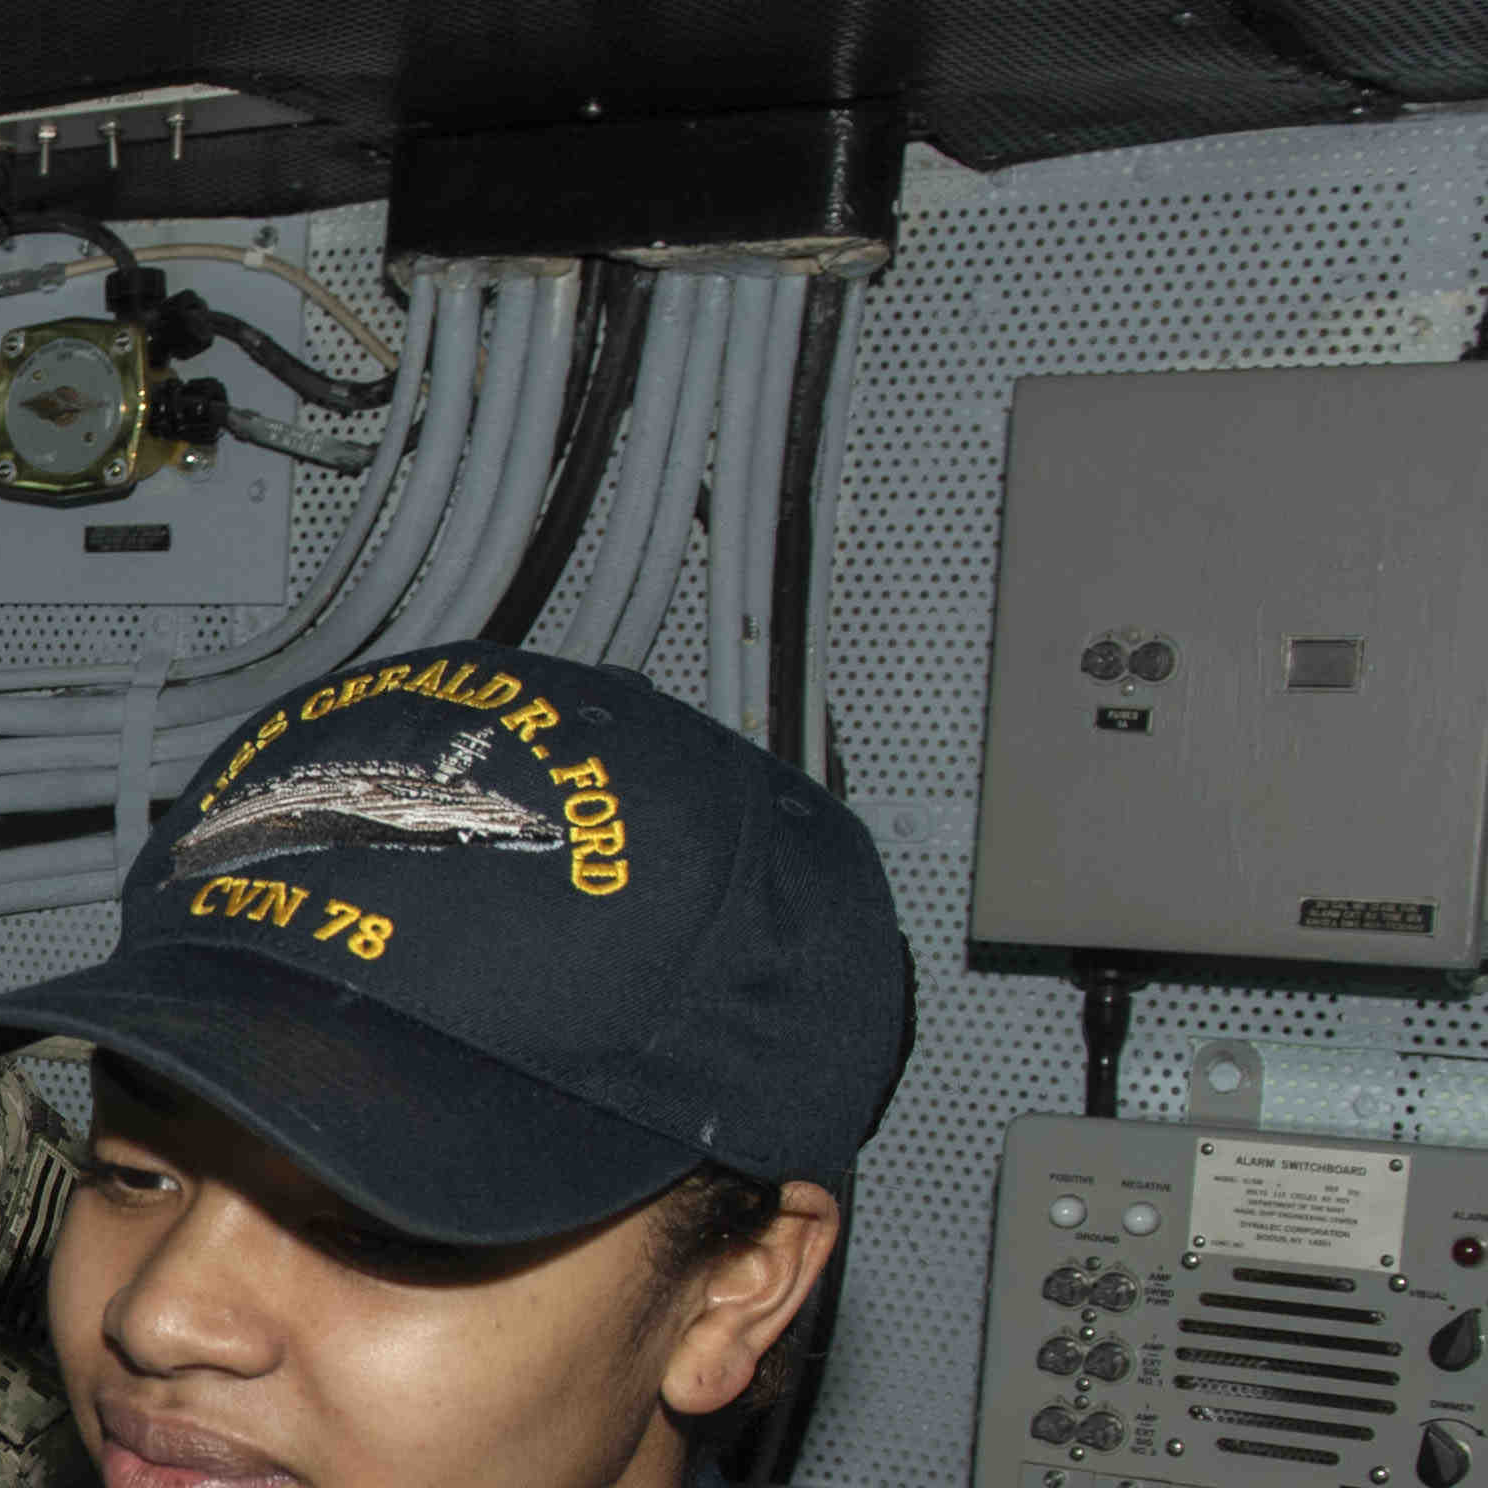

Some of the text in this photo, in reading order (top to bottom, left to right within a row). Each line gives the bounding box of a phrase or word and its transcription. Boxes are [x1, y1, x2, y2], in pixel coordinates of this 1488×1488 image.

[301, 659, 522, 721] GERALD
[500, 696, 560, 760] R.
[549, 757, 629, 896] FORD
[190, 876, 394, 959] CVN 78
[1236, 1155, 1366, 1176] ALARM SWITCHBOARD
[1050, 1173, 1094, 1185] POSITIVE
[1121, 1180, 1172, 1192] NEGATIVE
[1075, 1233, 1120, 1245] GROUND
[1409, 1288, 1448, 1302] VISUAL
[1430, 1398, 1476, 1414] DIMMER
